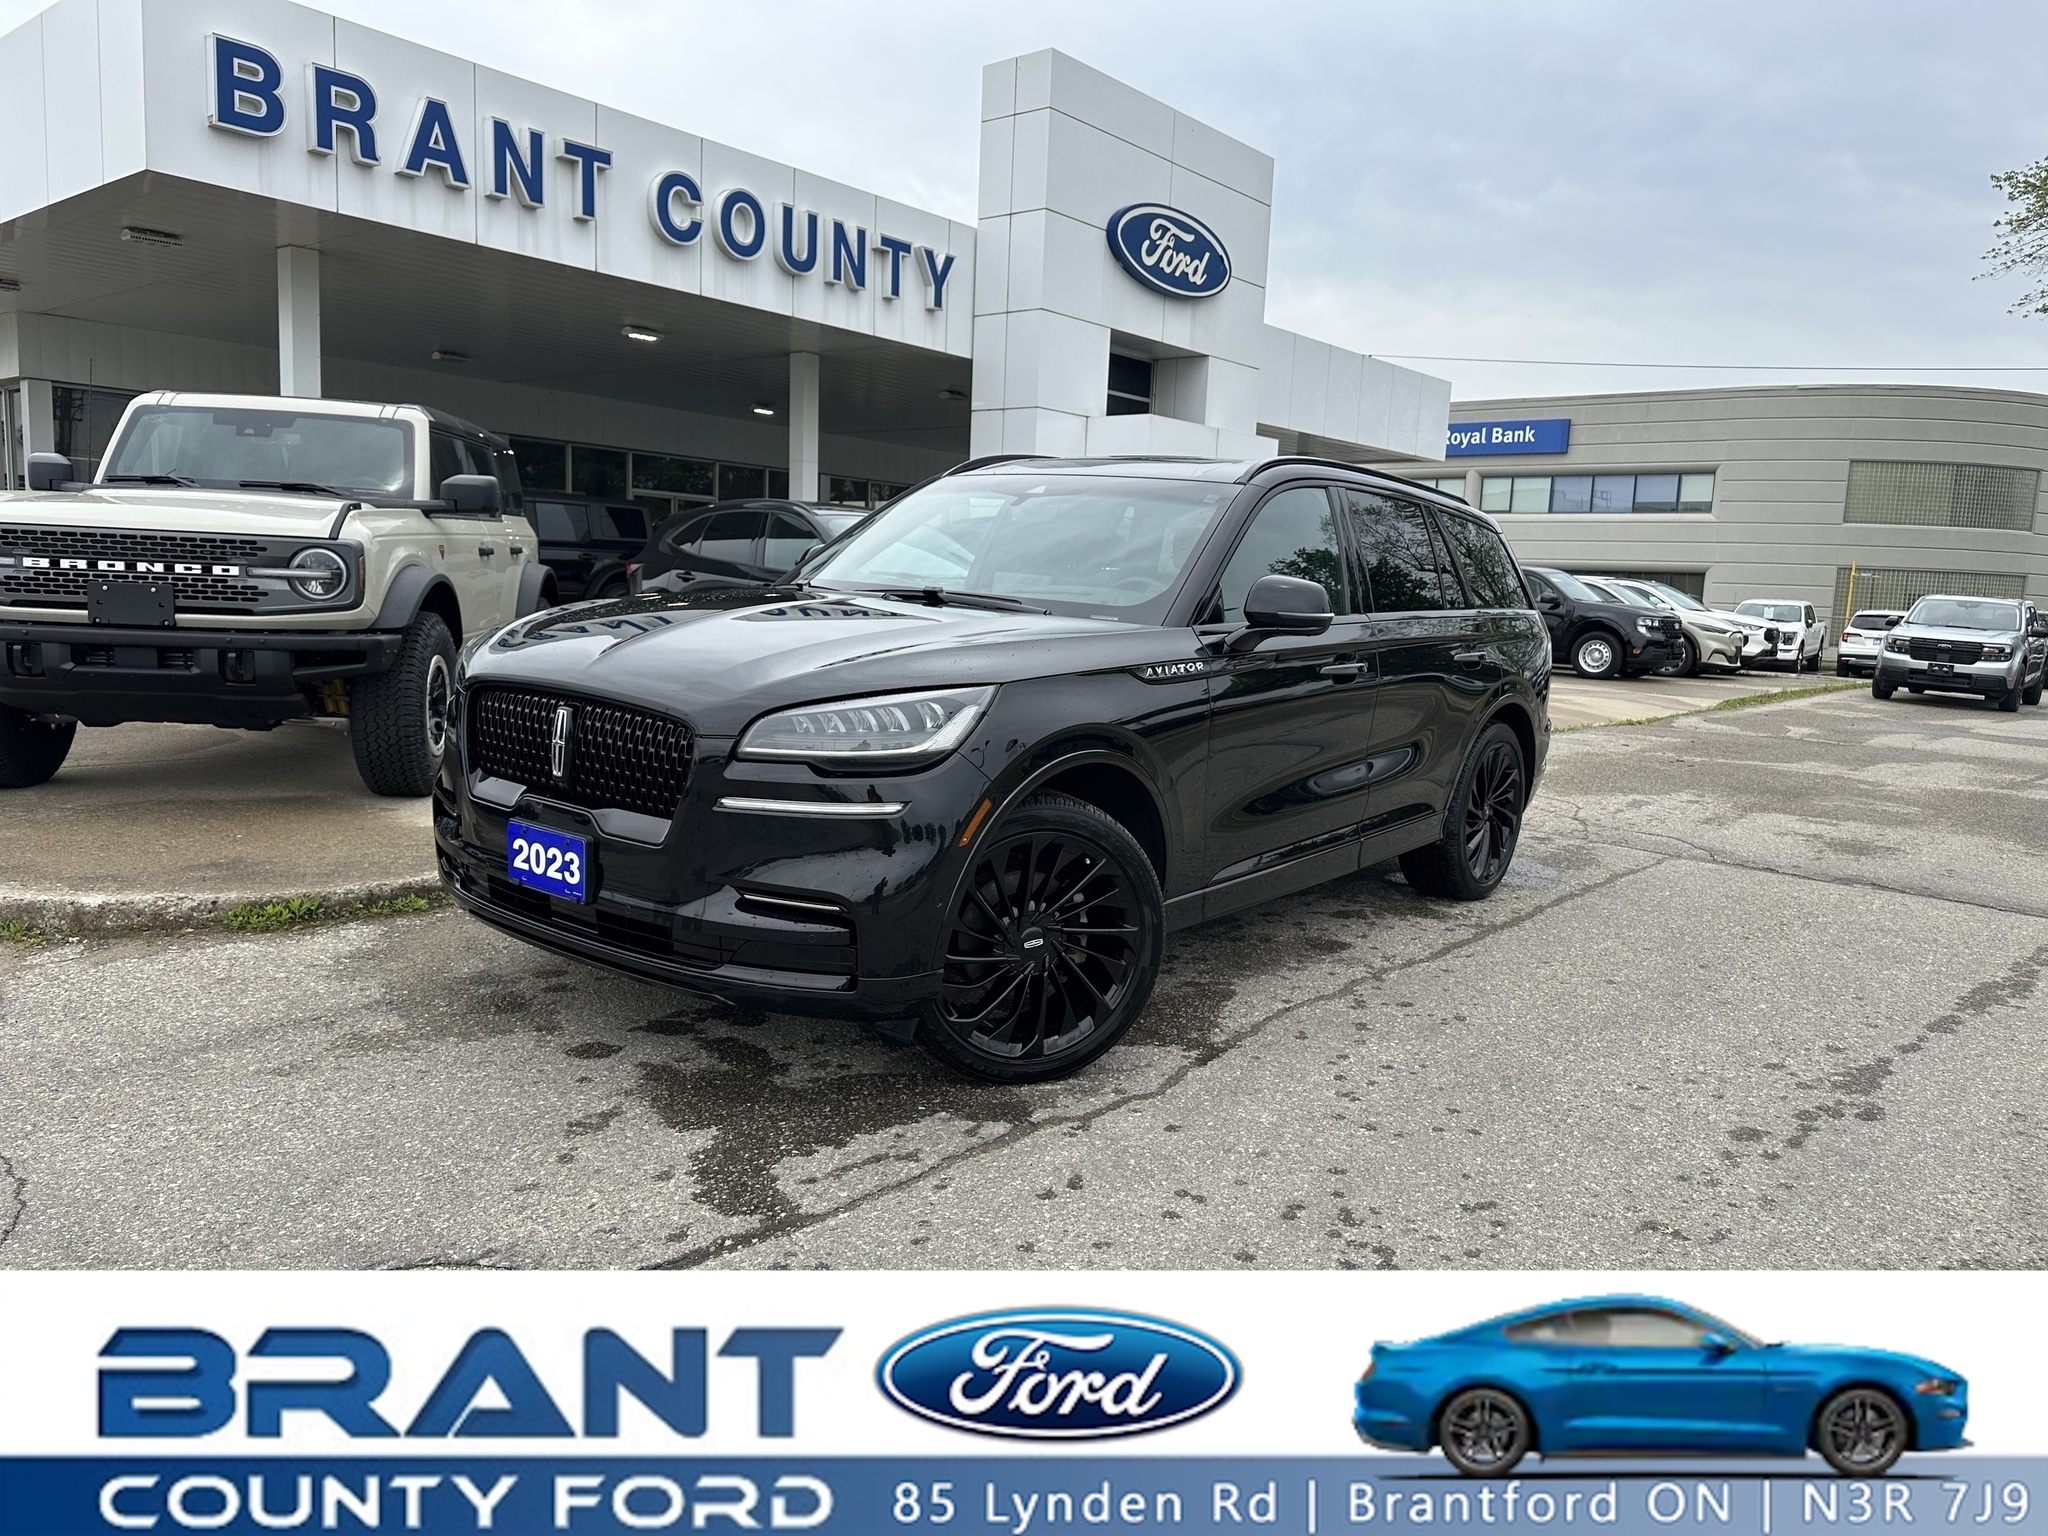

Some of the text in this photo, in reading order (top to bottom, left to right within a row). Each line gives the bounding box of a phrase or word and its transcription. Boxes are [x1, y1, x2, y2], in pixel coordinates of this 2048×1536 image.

[206, 32, 957, 312] BRANT COUNTY
[1141, 218, 1210, 286] Ford
[1491, 425, 1536, 444] Bank
[22, 556, 240, 577] BRONCO
[1145, 661, 1204, 677] AVIATOR
[512, 837, 581, 885] 2023
